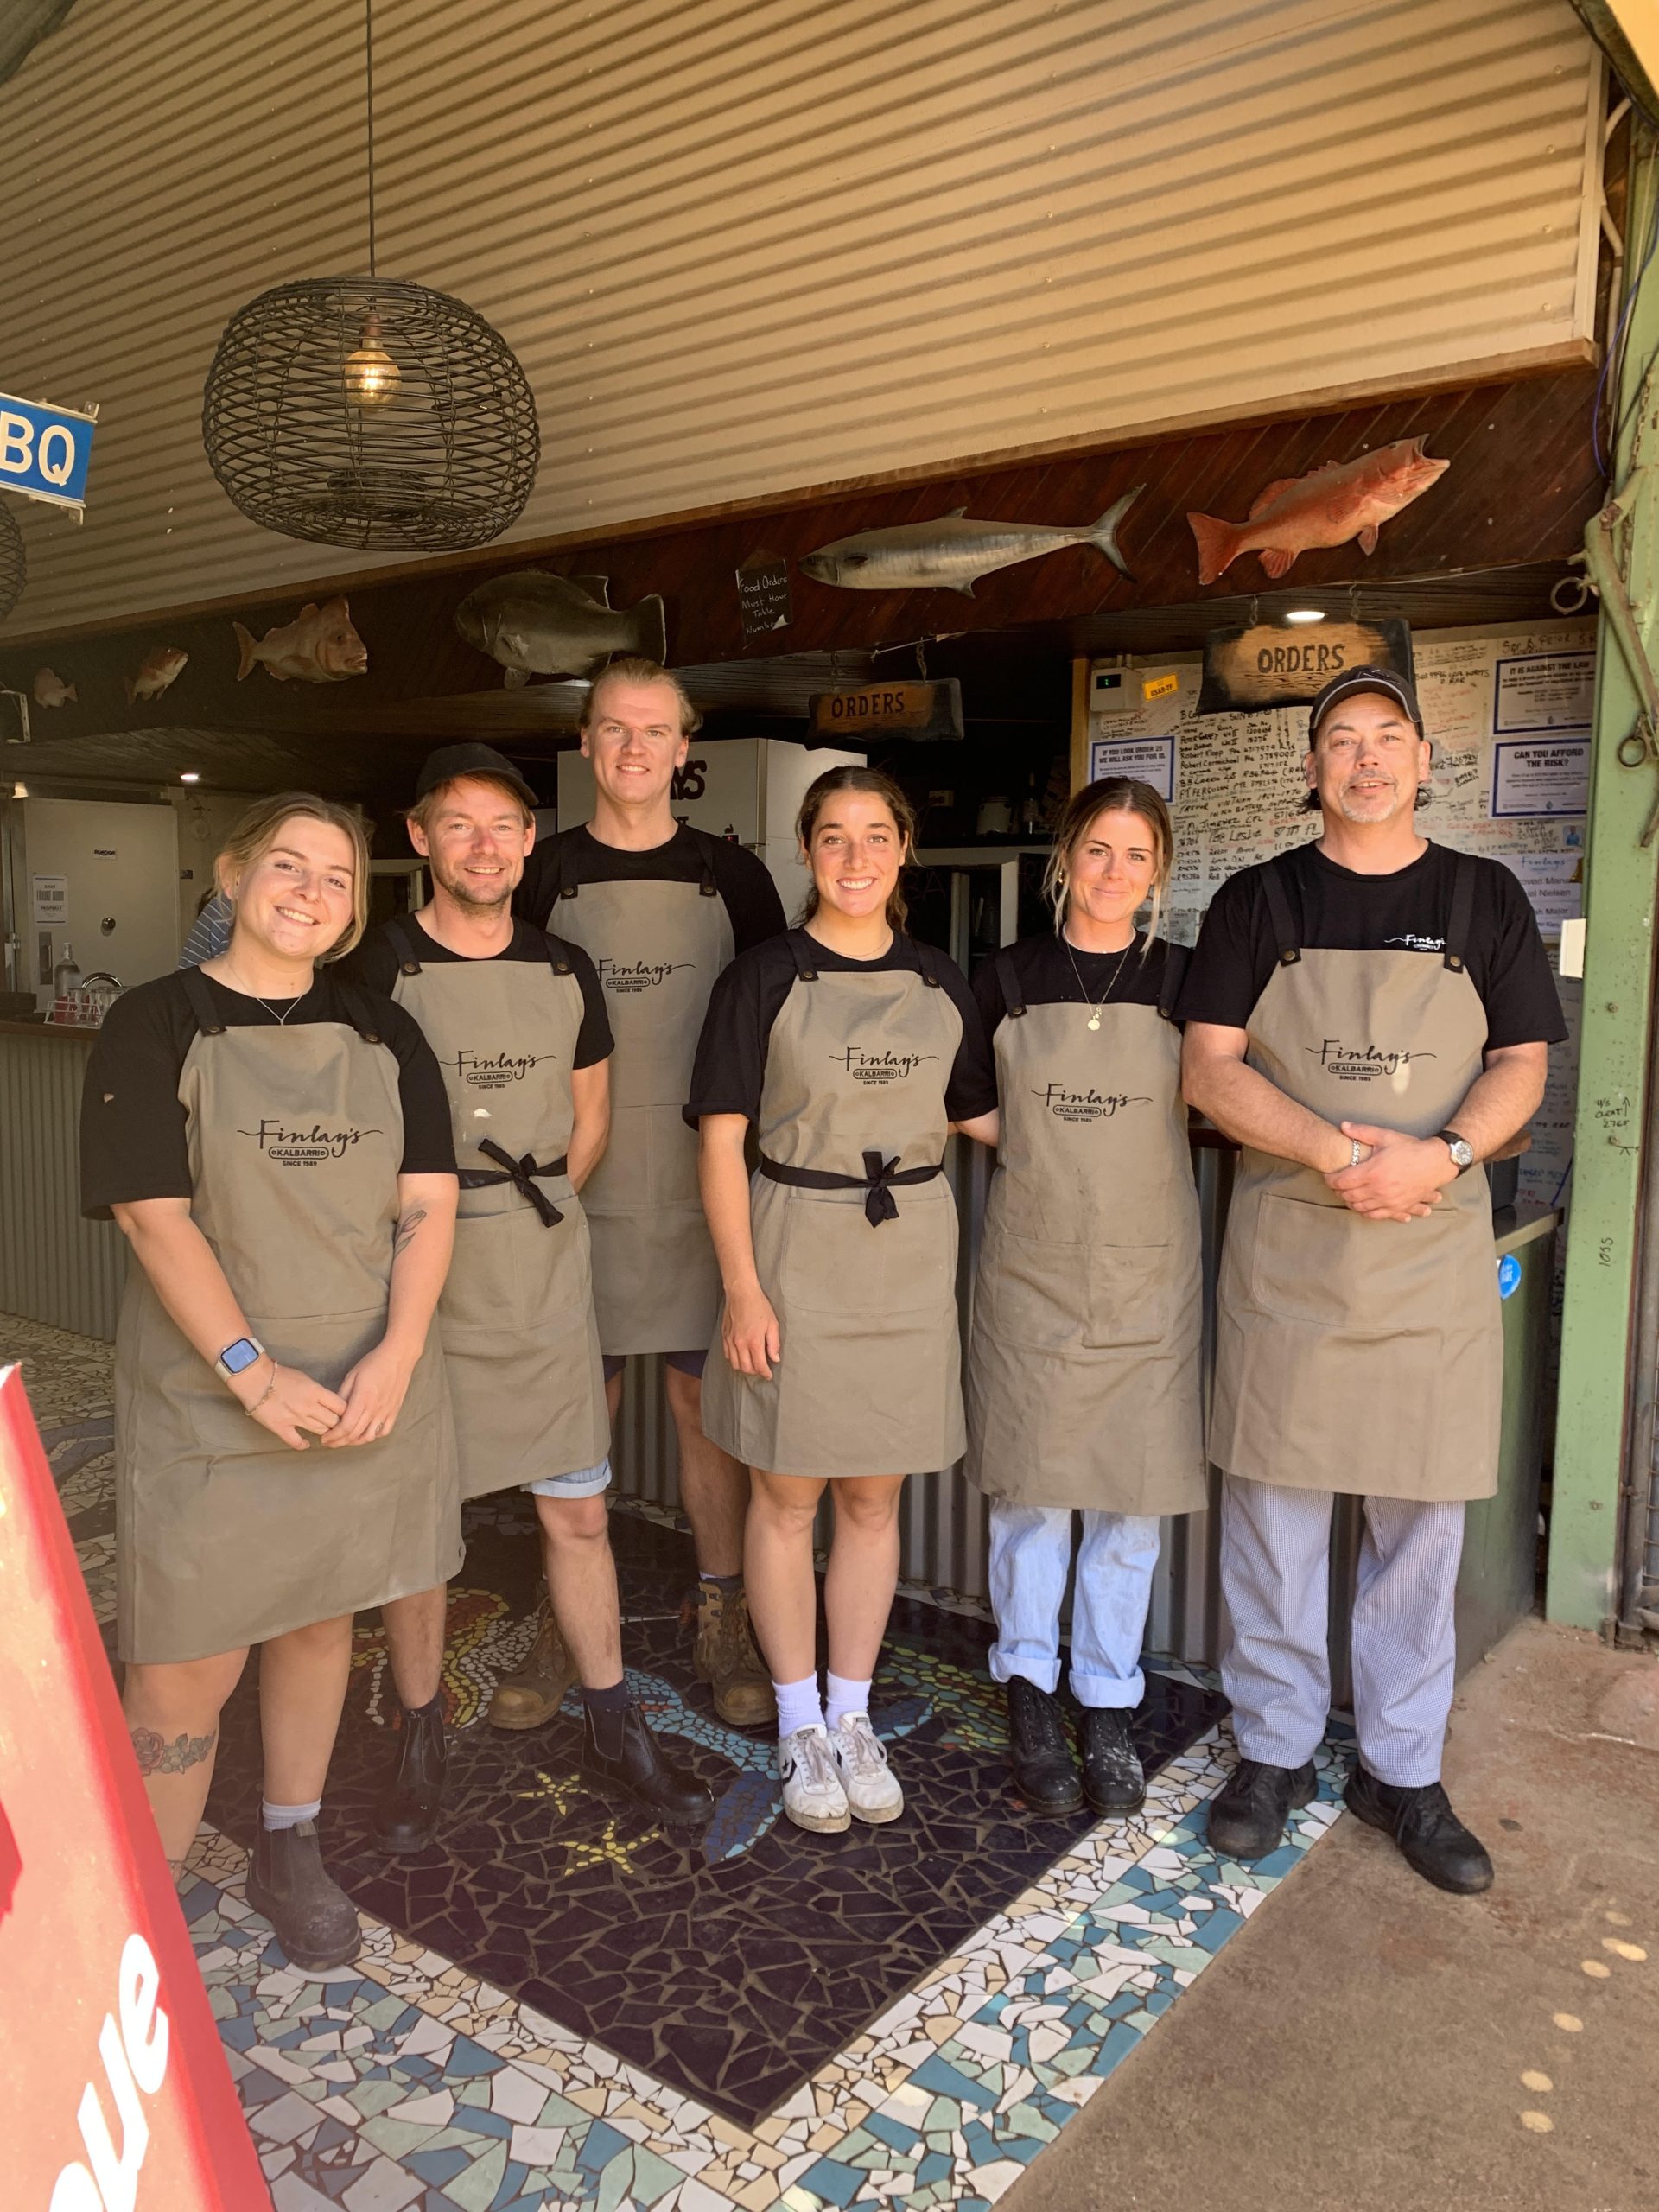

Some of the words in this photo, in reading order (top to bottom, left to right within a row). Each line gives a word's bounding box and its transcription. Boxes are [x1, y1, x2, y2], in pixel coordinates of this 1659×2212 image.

[739, 578, 760, 593] Food
[762, 575, 788, 589] Orders
[742, 595, 765, 609] Must
[768, 594, 788, 602] Have
[753, 607, 775, 617] Table
[746, 621, 777, 634] Numbe
[1257, 643, 1346, 673] ORDERS
[831, 691, 905, 718] ORDERS
[1544, 759, 1569, 767] RISK?
[1550, 748, 1584, 757] AFFORD
[596, 959, 696, 985] Finlay's
[440, 1051, 557, 1080] Finlay's
[830, 1046, 939, 1077] Finlay's
[1306, 1039, 1437, 1075] Finlay's
[1031, 1084, 1154, 1116] Finlay's
[237, 1120, 384, 1158] Finlay's
